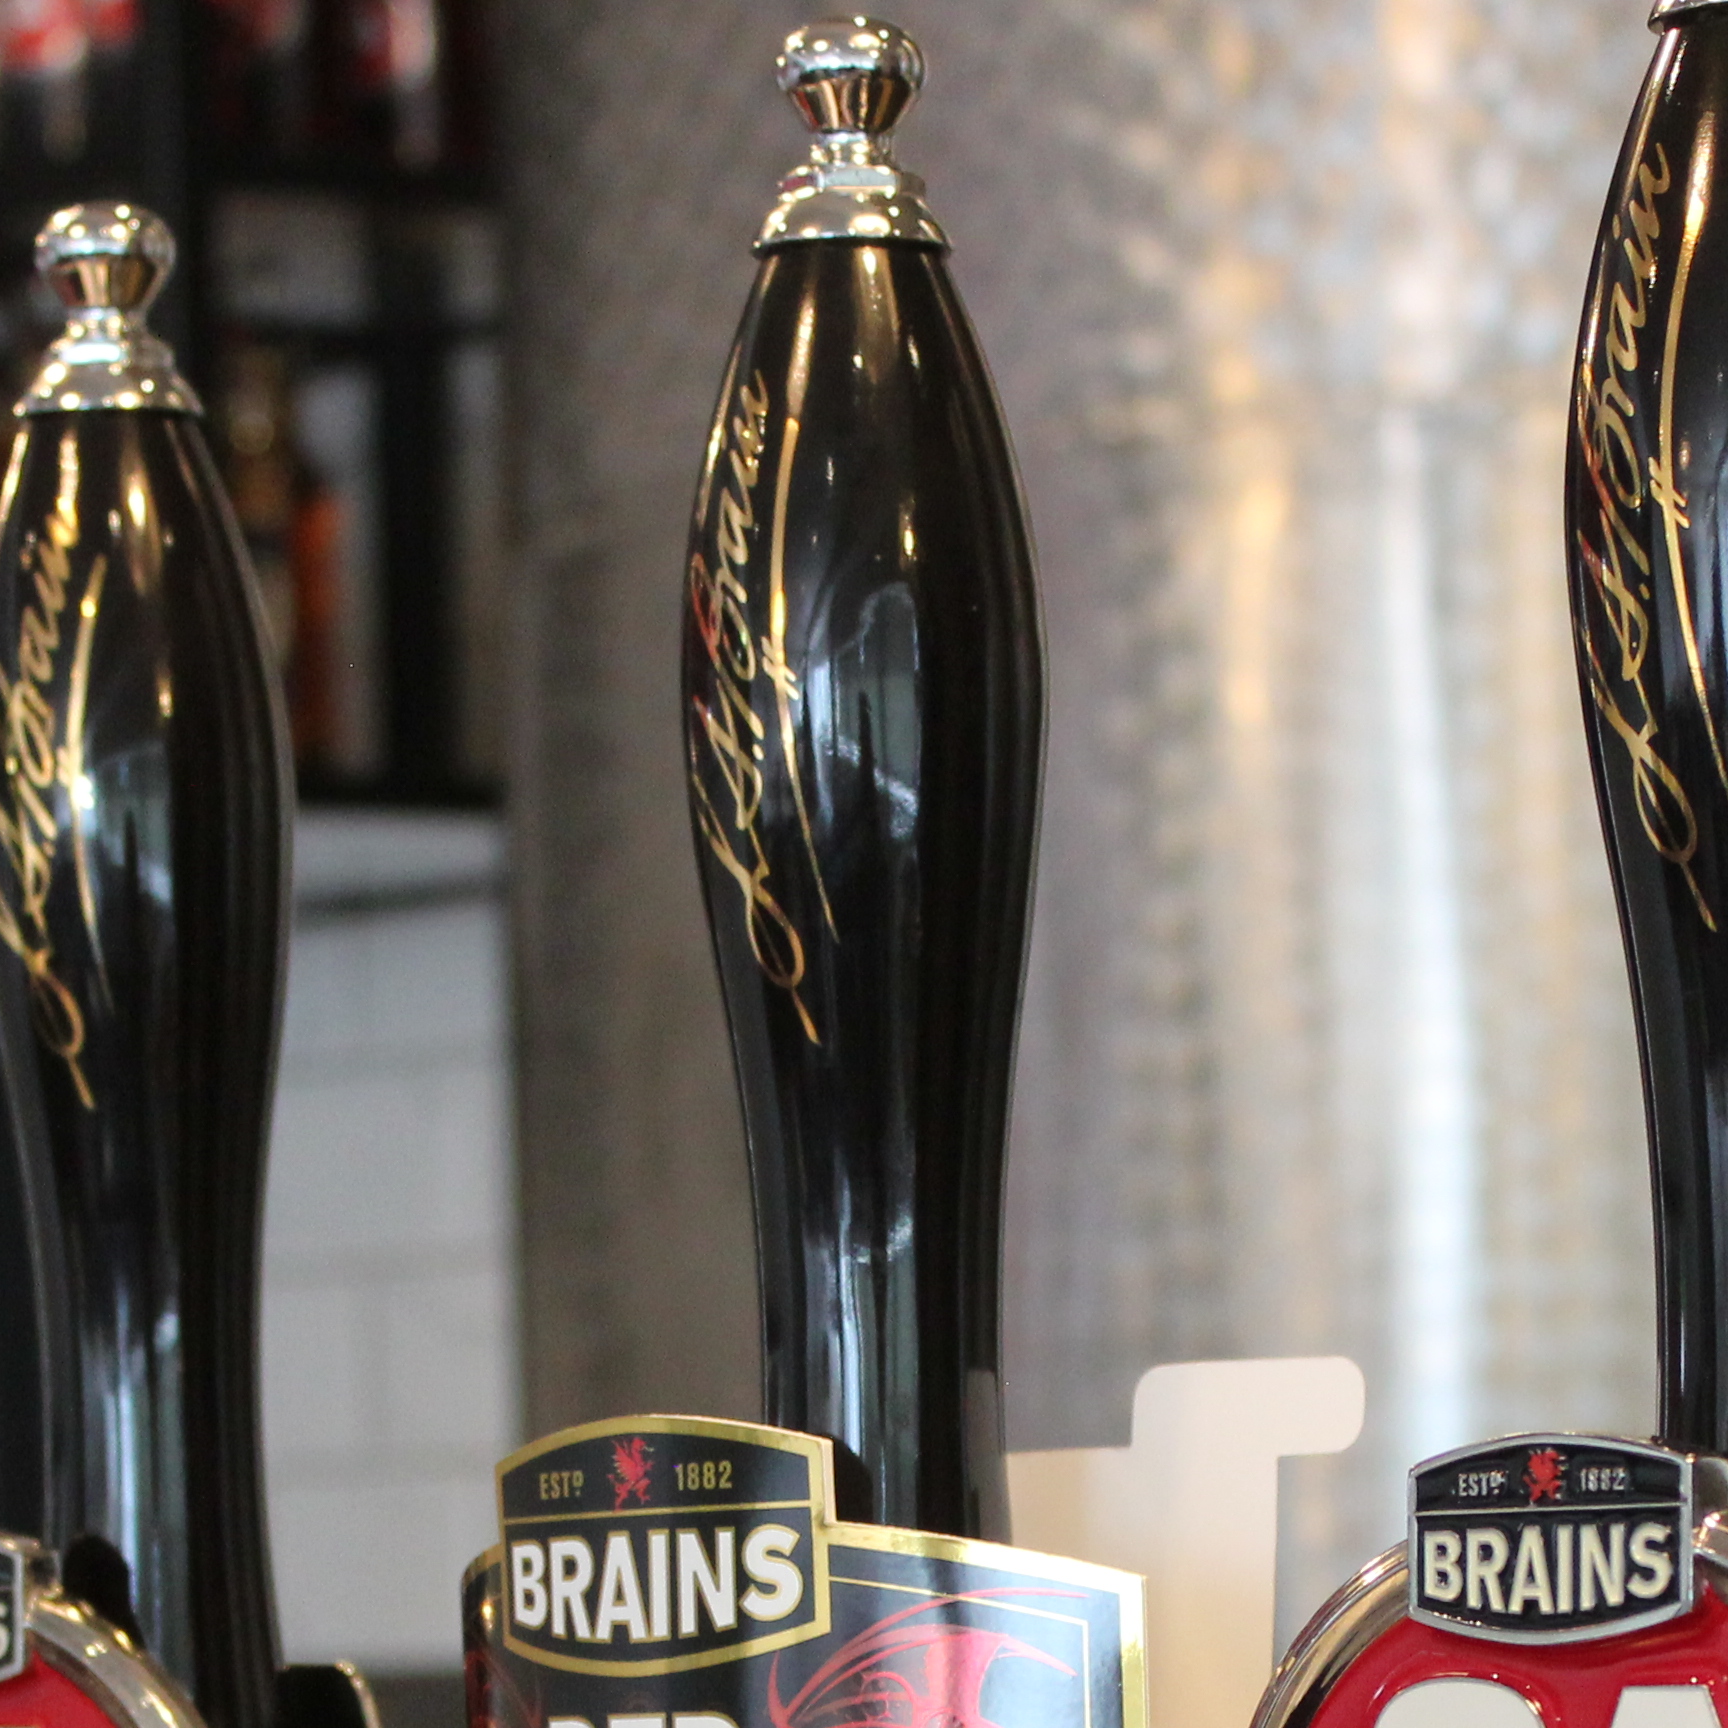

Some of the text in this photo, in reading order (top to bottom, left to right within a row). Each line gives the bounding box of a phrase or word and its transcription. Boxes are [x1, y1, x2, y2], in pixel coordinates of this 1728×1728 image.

[675, 1460, 733, 1491] 1882
[1580, 1467, 1627, 1491] 1882
[511, 1523, 804, 1645] BRAINS
[1424, 1522, 1672, 1615] BRAINS
